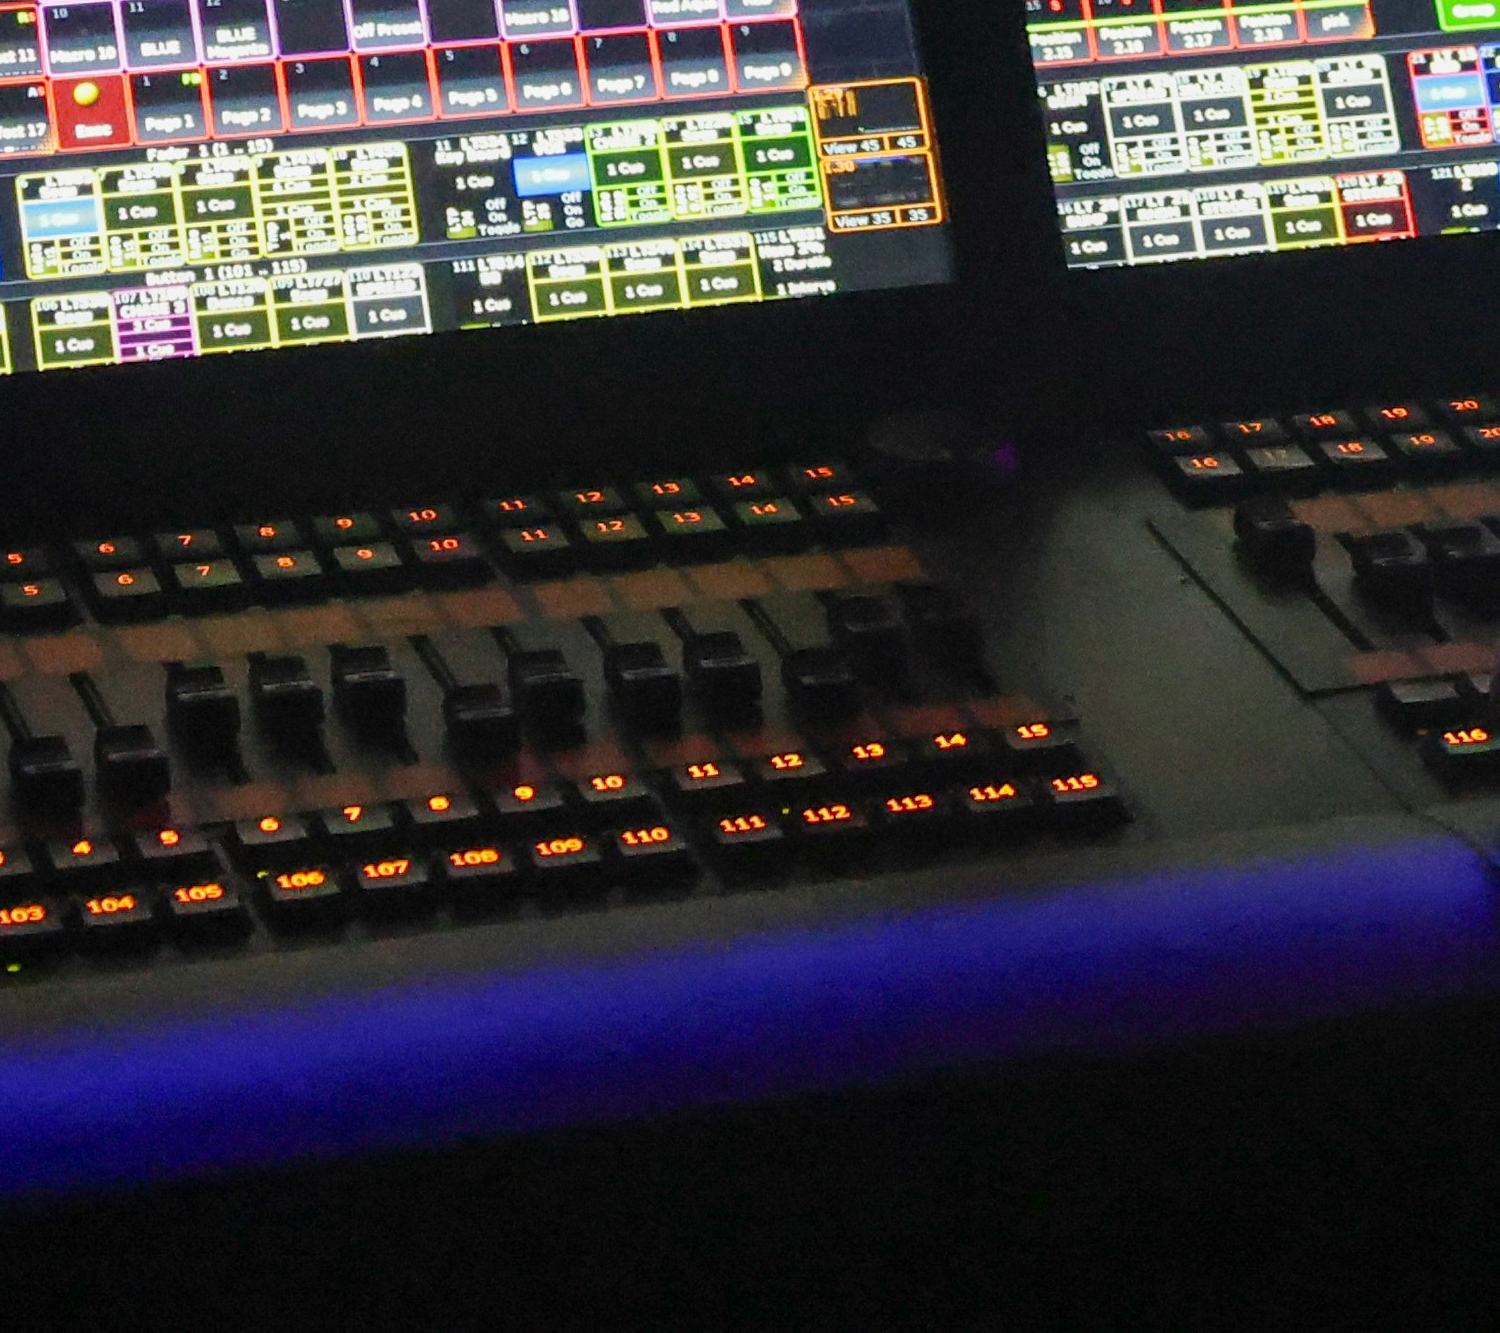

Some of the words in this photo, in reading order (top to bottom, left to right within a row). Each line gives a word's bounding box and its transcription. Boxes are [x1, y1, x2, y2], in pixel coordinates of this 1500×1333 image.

[145, 116, 181, 133] Page
[185, 114, 194, 129] 1
[221, 110, 256, 127] Page
[259, 108, 271, 122] 2
[823, 140, 858, 156] View
[861, 138, 880, 152] 45
[897, 135, 917, 149] 45
[147, 147, 189, 162] Fader
[835, 213, 870, 228] View
[872, 211, 892, 226] 35
[909, 208, 928, 222] 35
[7, 553, 23, 564] 5
[98, 542, 116, 554] 6
[179, 534, 193, 546] 7
[259, 526, 276, 537] 8
[336, 517, 354, 530] 9
[409, 509, 437, 522] 10
[500, 499, 527, 511] 11
[575, 491, 604, 503] 12
[652, 482, 680, 495] 13
[728, 475, 756, 487] 14
[805, 466, 833, 479] 15
[22, 584, 40, 596] 5
[116, 573, 135, 585] 6
[197, 565, 211, 576] 7
[276, 556, 295, 570] 8
[355, 548, 376, 560] 9
[430, 538, 460, 552] 10
[520, 529, 549, 542] 11
[597, 520, 626, 533] 12
[673, 511, 702, 524] 13
[750, 503, 780, 516] 14
[827, 495, 856, 507] 15
[1443, 728, 1489, 747] 116
[72, 840, 93, 856] 4
[158, 829, 180, 848] 5
[258, 816, 282, 834] 6
[343, 805, 363, 822] 7
[427, 795, 451, 813] 8
[513, 785, 536, 802] 9
[591, 774, 626, 792] 10
[688, 762, 720, 780] 11
[770, 753, 804, 770] 12
[852, 742, 886, 760] 13
[934, 733, 968, 750] 14
[1016, 723, 1050, 741] 15
[86, 894, 137, 915] 104
[174, 883, 224, 905] 105
[276, 869, 327, 890] 106
[362, 859, 410, 880] 107
[449, 848, 501, 868] 108
[535, 837, 585, 857] 109
[621, 826, 671, 847] 110
[719, 814, 766, 834] 111
[802, 804, 851, 824] 112
[886, 794, 935, 812] 113
[969, 783, 1017, 802] 114
[1052, 773, 1100, 794] 115
